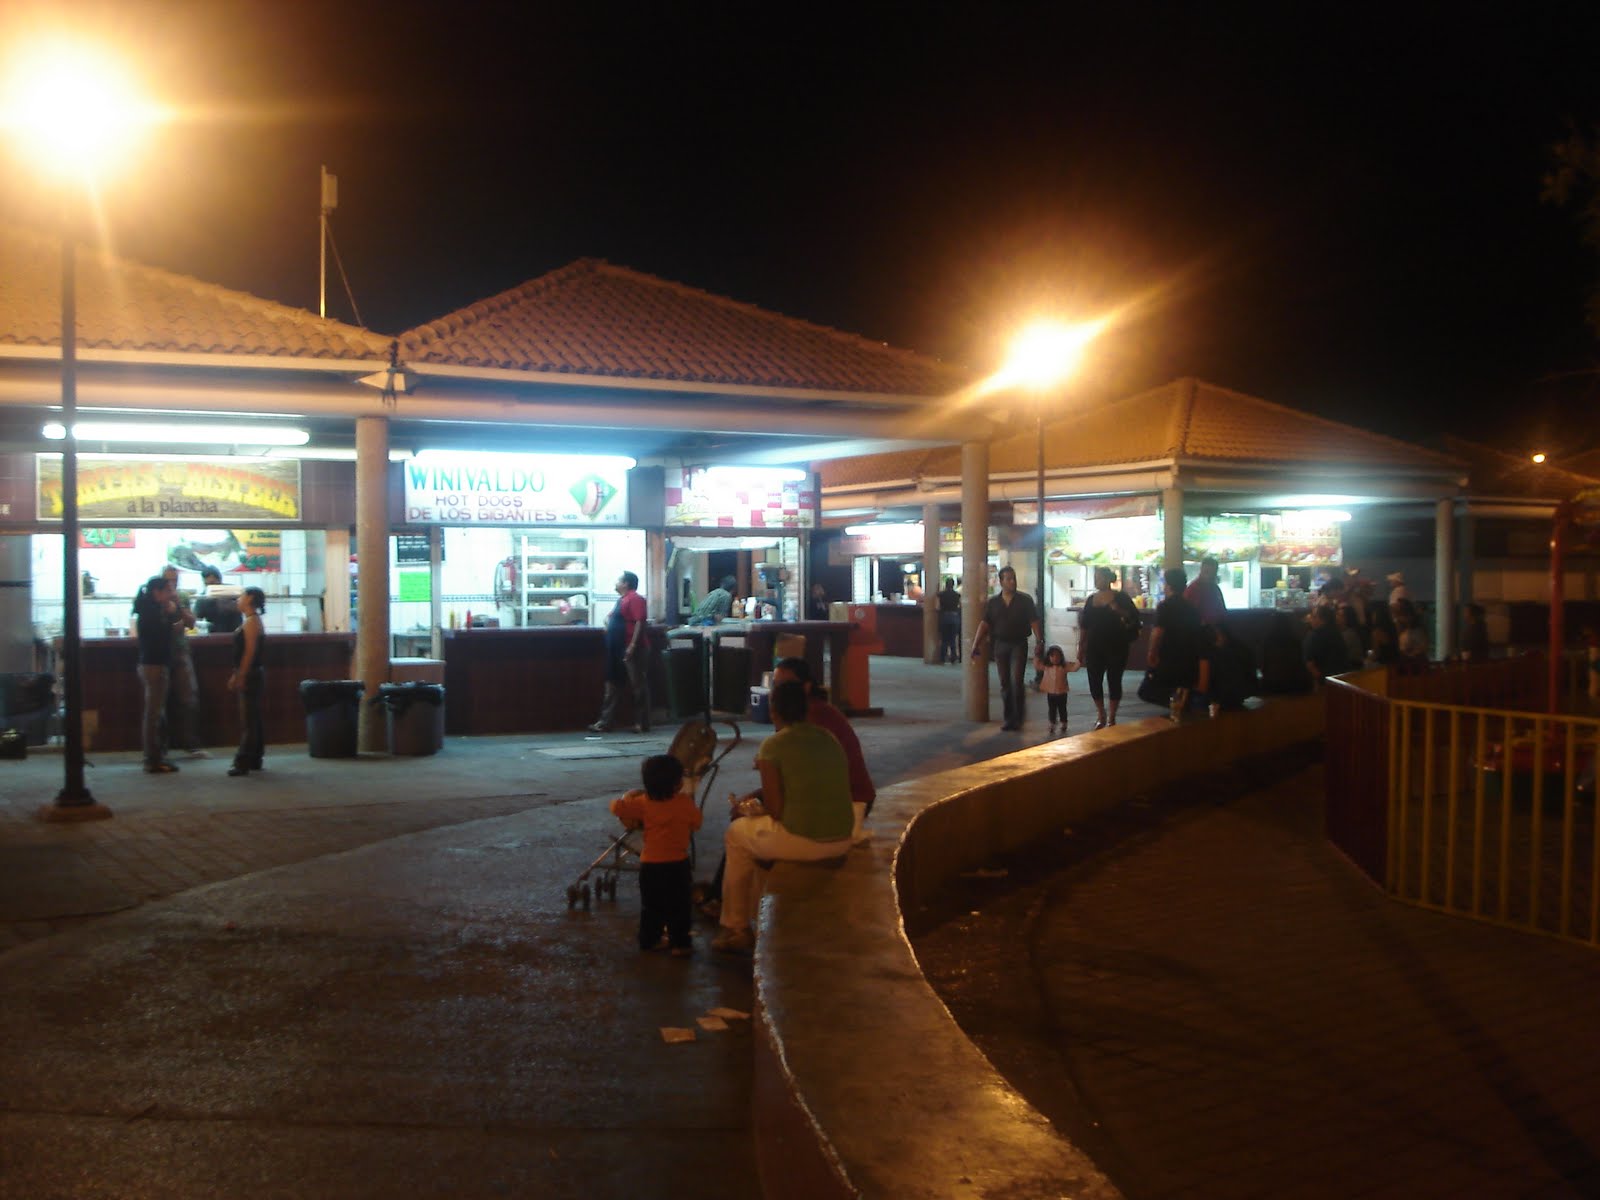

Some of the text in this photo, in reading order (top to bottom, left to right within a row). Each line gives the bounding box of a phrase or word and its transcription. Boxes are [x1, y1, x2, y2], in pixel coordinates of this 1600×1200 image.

[408, 465, 546, 493] WINIVALDO
[142, 496, 155, 513] la
[160, 496, 218, 517] plancha
[435, 495, 523, 508] HOT DOGS
[408, 507, 433, 521] DE
[440, 507, 472, 521] LOS
[478, 508, 557, 522] GIGANTES
